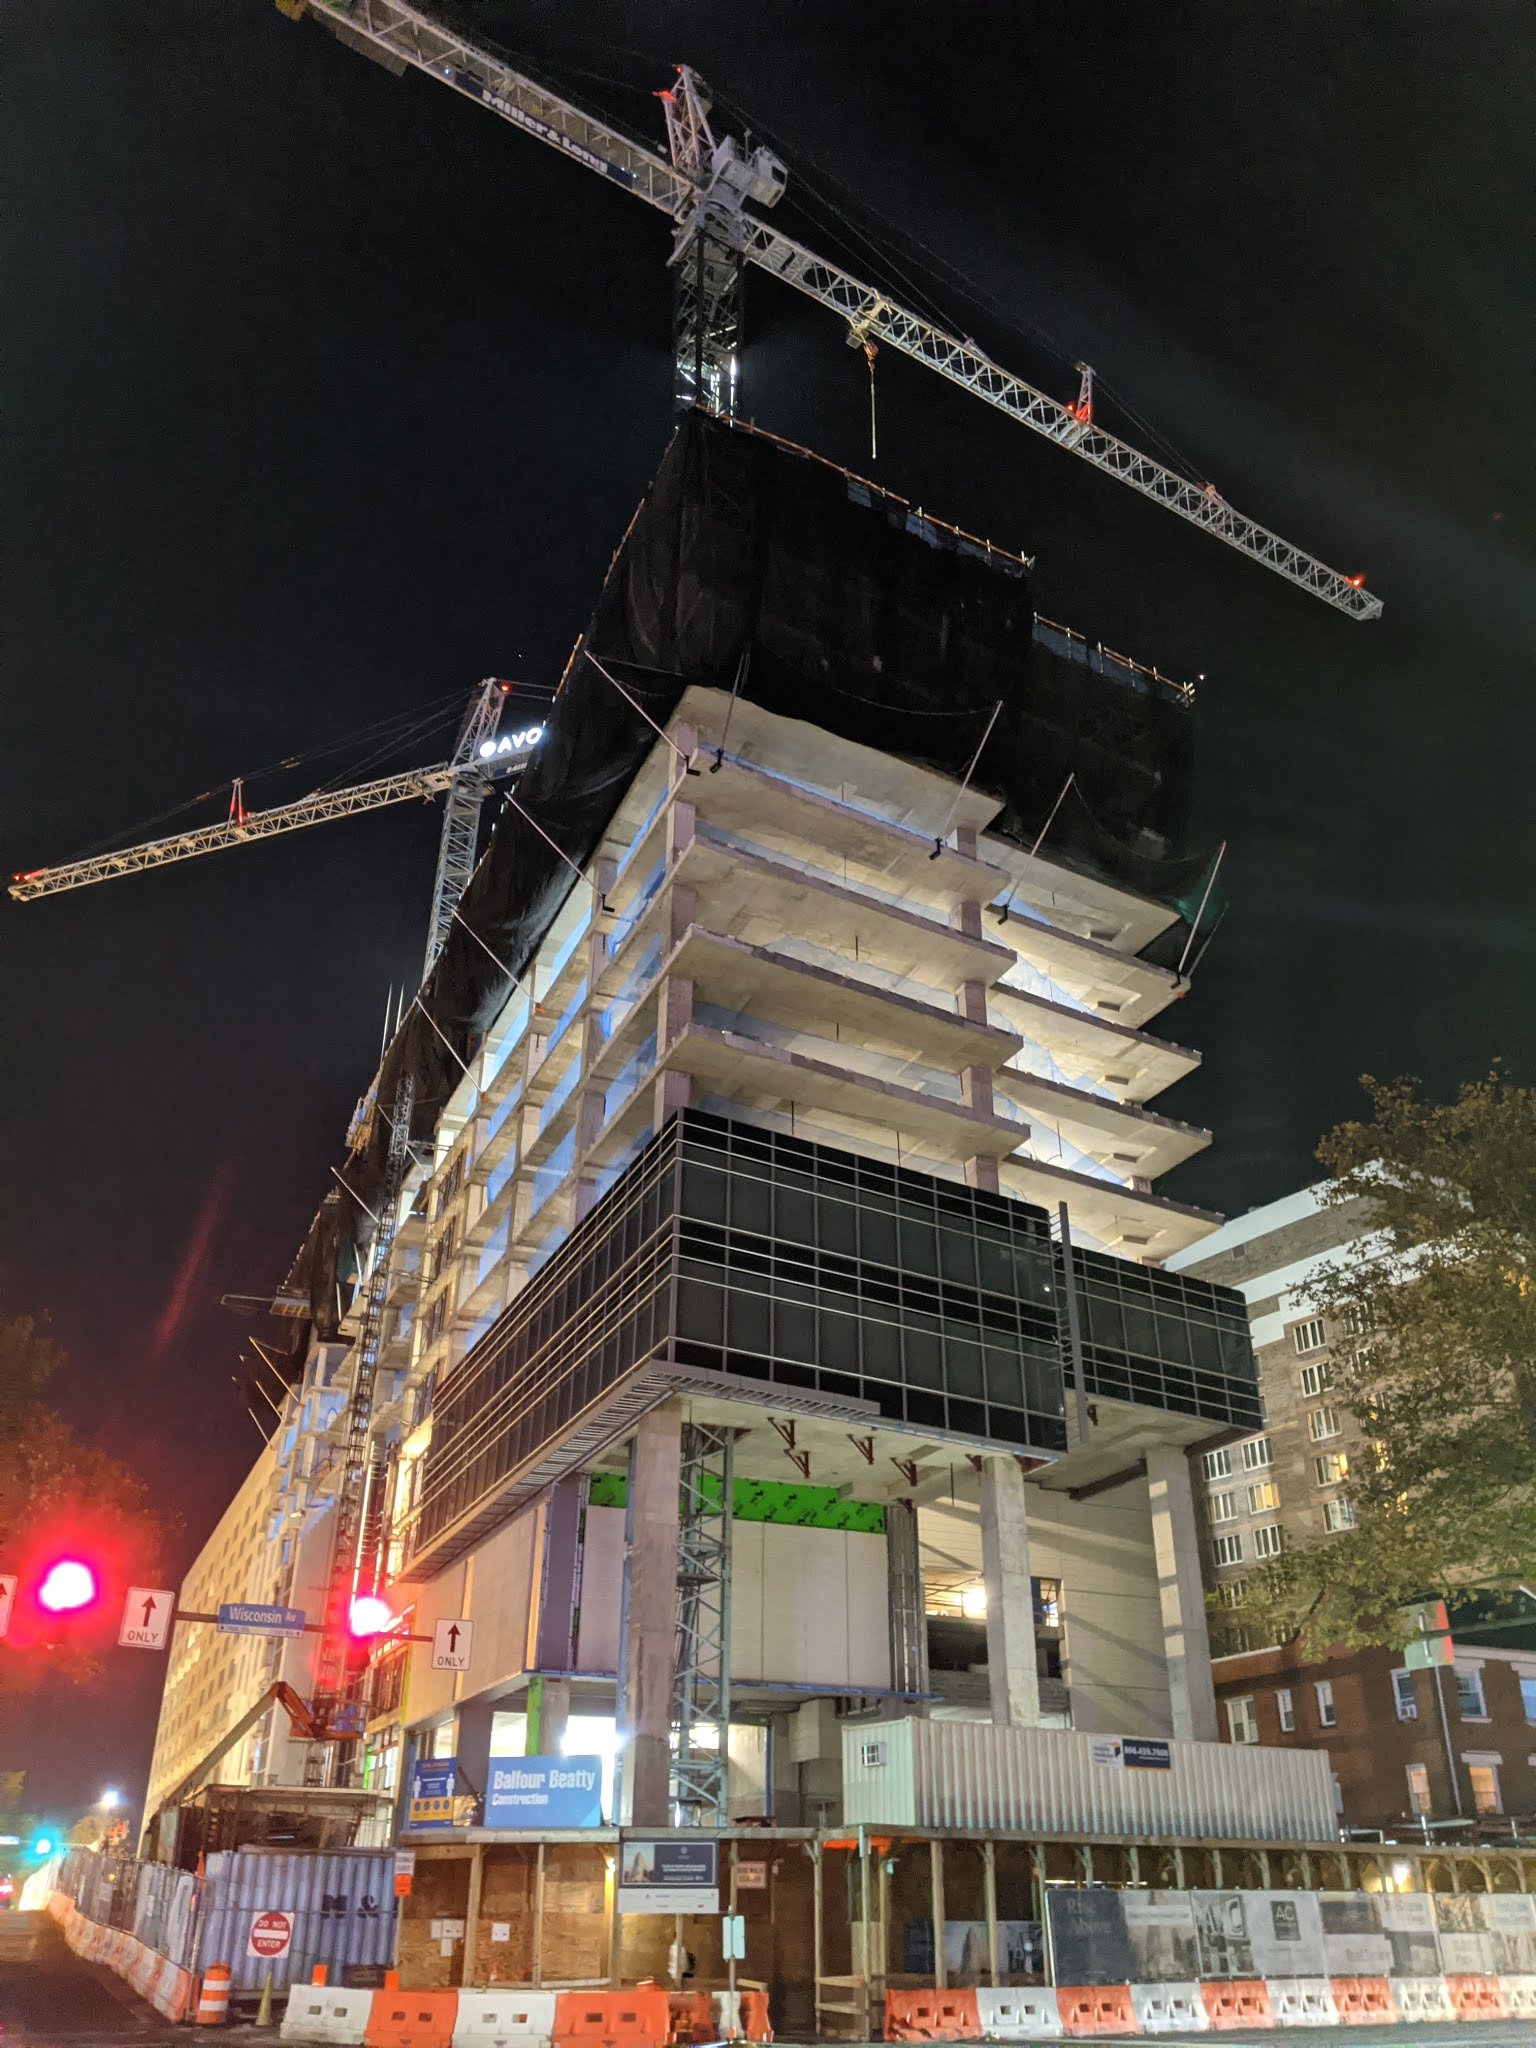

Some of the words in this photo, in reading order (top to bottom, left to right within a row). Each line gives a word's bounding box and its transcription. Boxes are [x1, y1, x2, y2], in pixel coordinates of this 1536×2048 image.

[229, 1606, 282, 1624] Wisconsin
[285, 1611, 297, 1622] Av
[127, 1630, 159, 1643] ONLY
[437, 1656, 465, 1667] ONLY
[493, 1770, 545, 1789] Balfour
[548, 1769, 596, 1791] Beatty
[492, 1793, 549, 1806] Construction
[1275, 1905, 1295, 1921] AC
[258, 1919, 269, 1927] DO
[272, 1920, 287, 1929] NOT
[257, 1939, 281, 1949] ENTER
